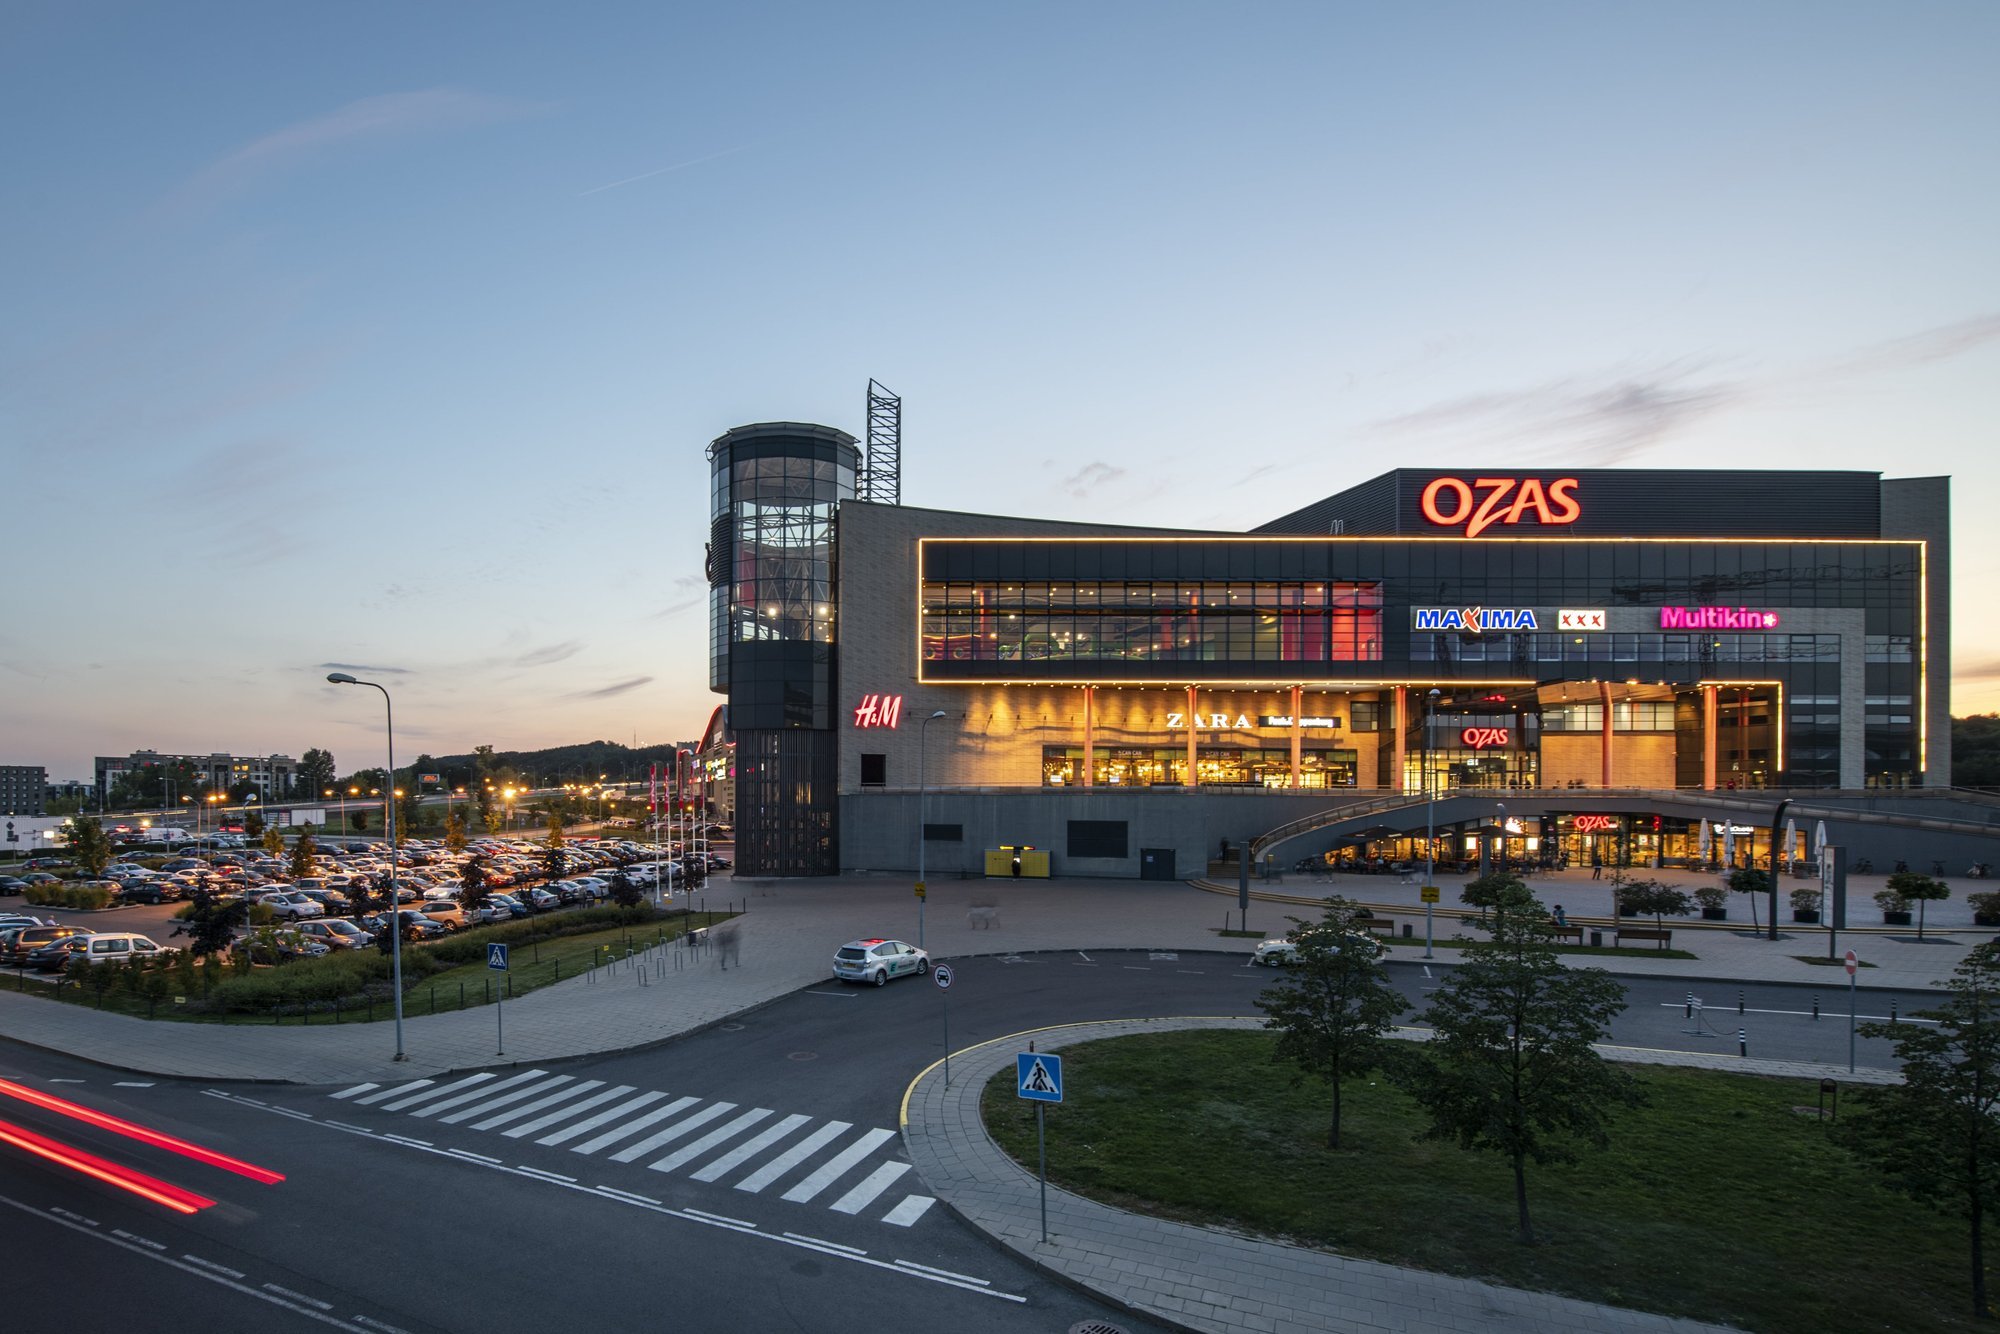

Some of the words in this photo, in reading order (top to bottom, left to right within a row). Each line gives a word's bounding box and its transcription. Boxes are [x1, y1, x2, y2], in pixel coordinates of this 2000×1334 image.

[1421, 477, 1581, 538] OZAS
[1416, 606, 1538, 633] MAXIMA
[855, 695, 902, 729] H&M
[1166, 713, 1253, 729] ZARA
[1463, 728, 1508, 749] OZAS
[1575, 815, 1610, 833] OZAS
